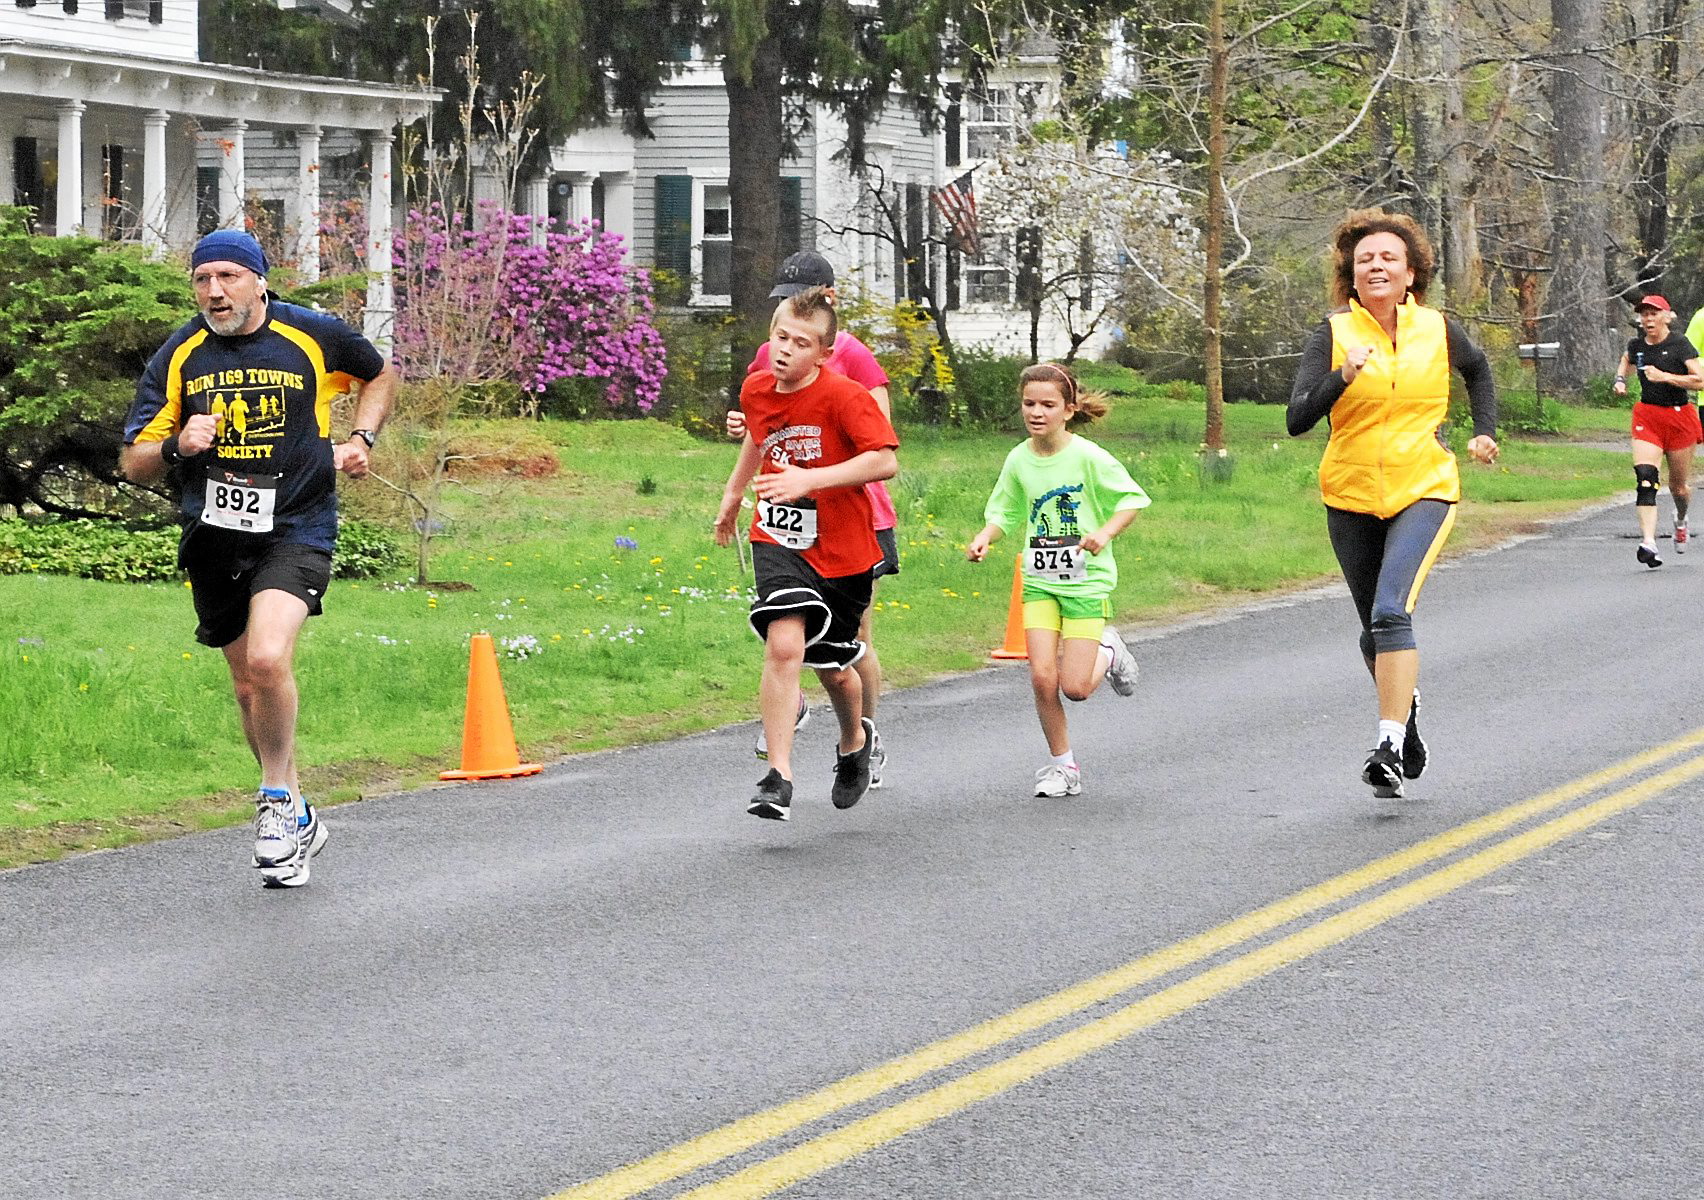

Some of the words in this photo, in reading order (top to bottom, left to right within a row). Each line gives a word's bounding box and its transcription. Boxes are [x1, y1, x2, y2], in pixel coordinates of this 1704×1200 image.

[186, 373, 215, 396] RUN
[218, 369, 244, 386] 169
[246, 368, 304, 390] TOWNS
[217, 444, 274, 459] SOCIETY
[215, 485, 260, 515] 892
[766, 505, 803, 533] 122
[1034, 549, 1074, 570] 874
